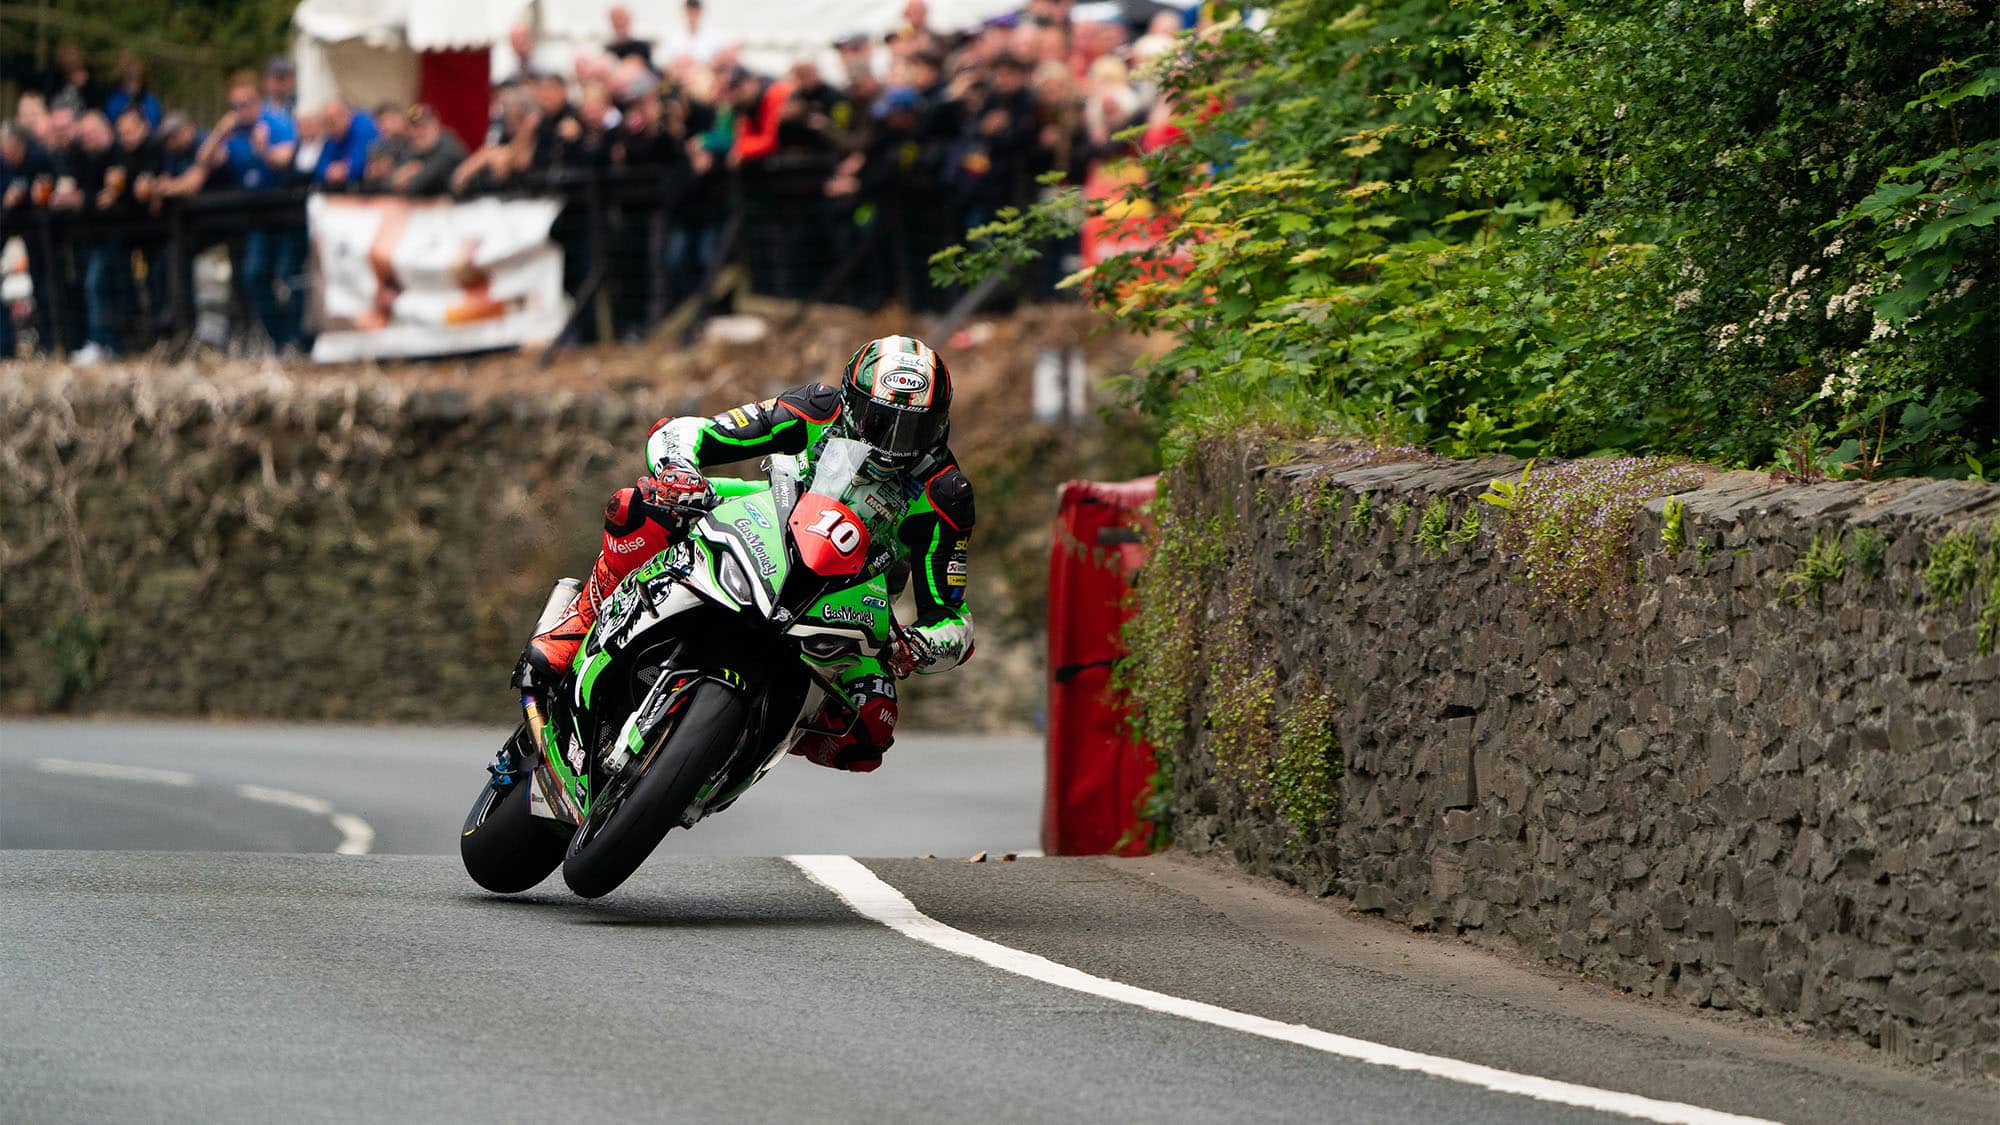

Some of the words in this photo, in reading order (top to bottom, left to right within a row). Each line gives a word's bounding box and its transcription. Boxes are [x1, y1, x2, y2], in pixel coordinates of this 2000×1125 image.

[886, 374, 924, 387] SUOMY
[806, 509, 860, 553] 10
[606, 535, 646, 554] Weise
[734, 518, 777, 577] GasMonkey
[872, 678, 895, 699] 10
